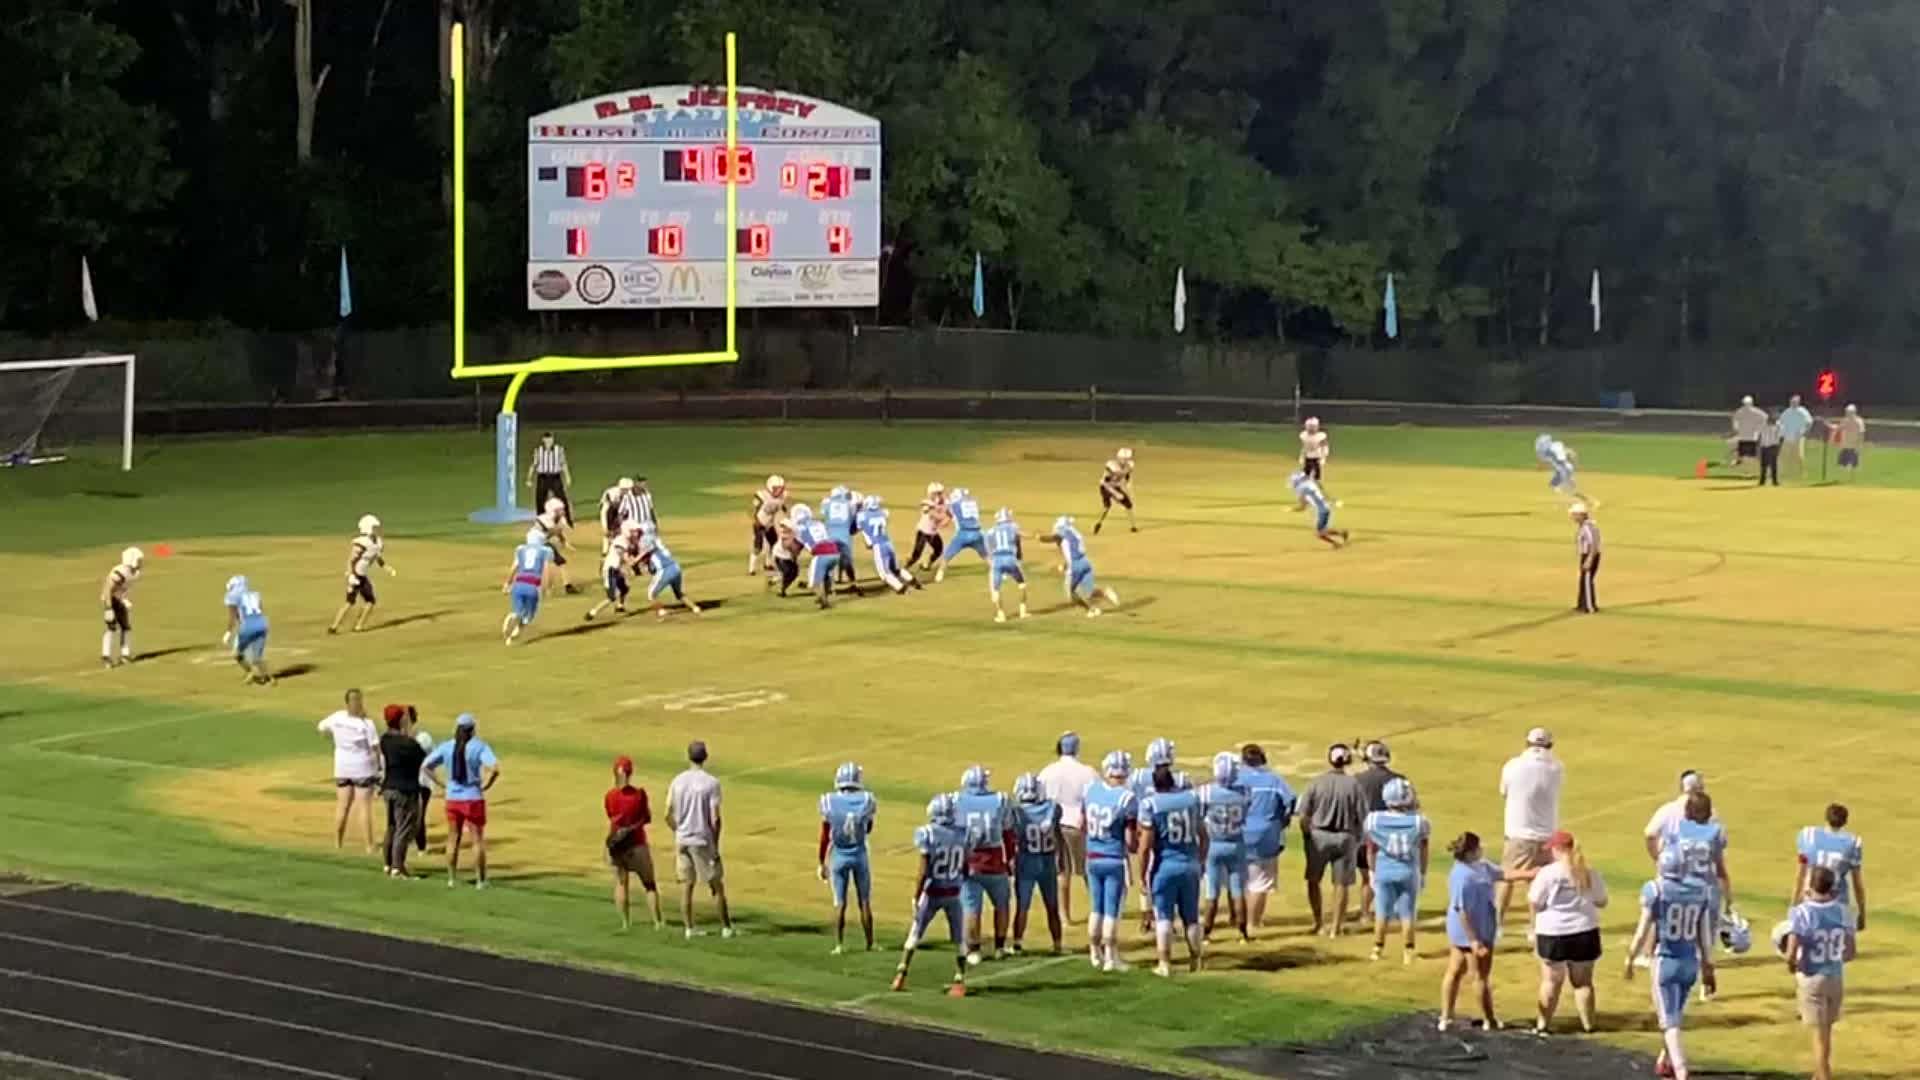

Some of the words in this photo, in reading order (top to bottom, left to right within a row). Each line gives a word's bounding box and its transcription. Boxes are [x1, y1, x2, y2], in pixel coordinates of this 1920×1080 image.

[586, 164, 607, 199] 6
[617, 164, 636, 188] 2
[781, 164, 797, 188] 0
[807, 164, 849, 199] 21
[657, 225, 682, 257] 10
[750, 225, 770, 257] 0
[828, 225, 849, 255] 4
[842, 812, 857, 843] 4
[1086, 804, 1112, 838] 62
[1167, 810, 1192, 843] 61
[932, 847, 963, 880] 20
[1665, 903, 1701, 942] 80
[1808, 927, 1846, 963] 30
